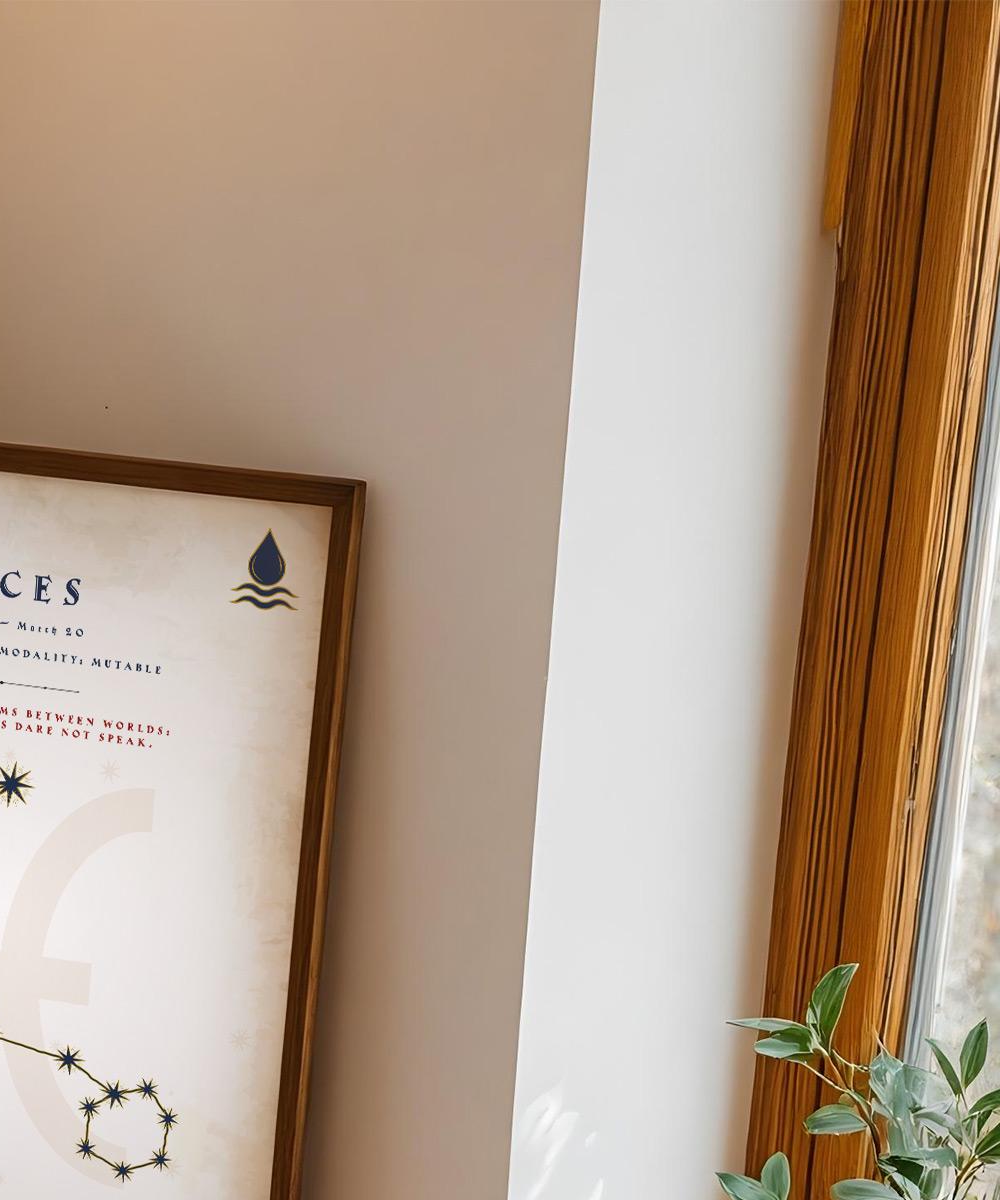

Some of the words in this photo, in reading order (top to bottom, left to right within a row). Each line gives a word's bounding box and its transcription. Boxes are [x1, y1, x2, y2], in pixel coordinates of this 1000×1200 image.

[16, 620, 58, 637] March
[65, 627, 84, 638] 20
[92, 657, 161, 675] MUTABLE
[26, 709, 95, 729] BETWEEN
[15, 721, 53, 736] DARE
[61, 727, 91, 740] NOT
